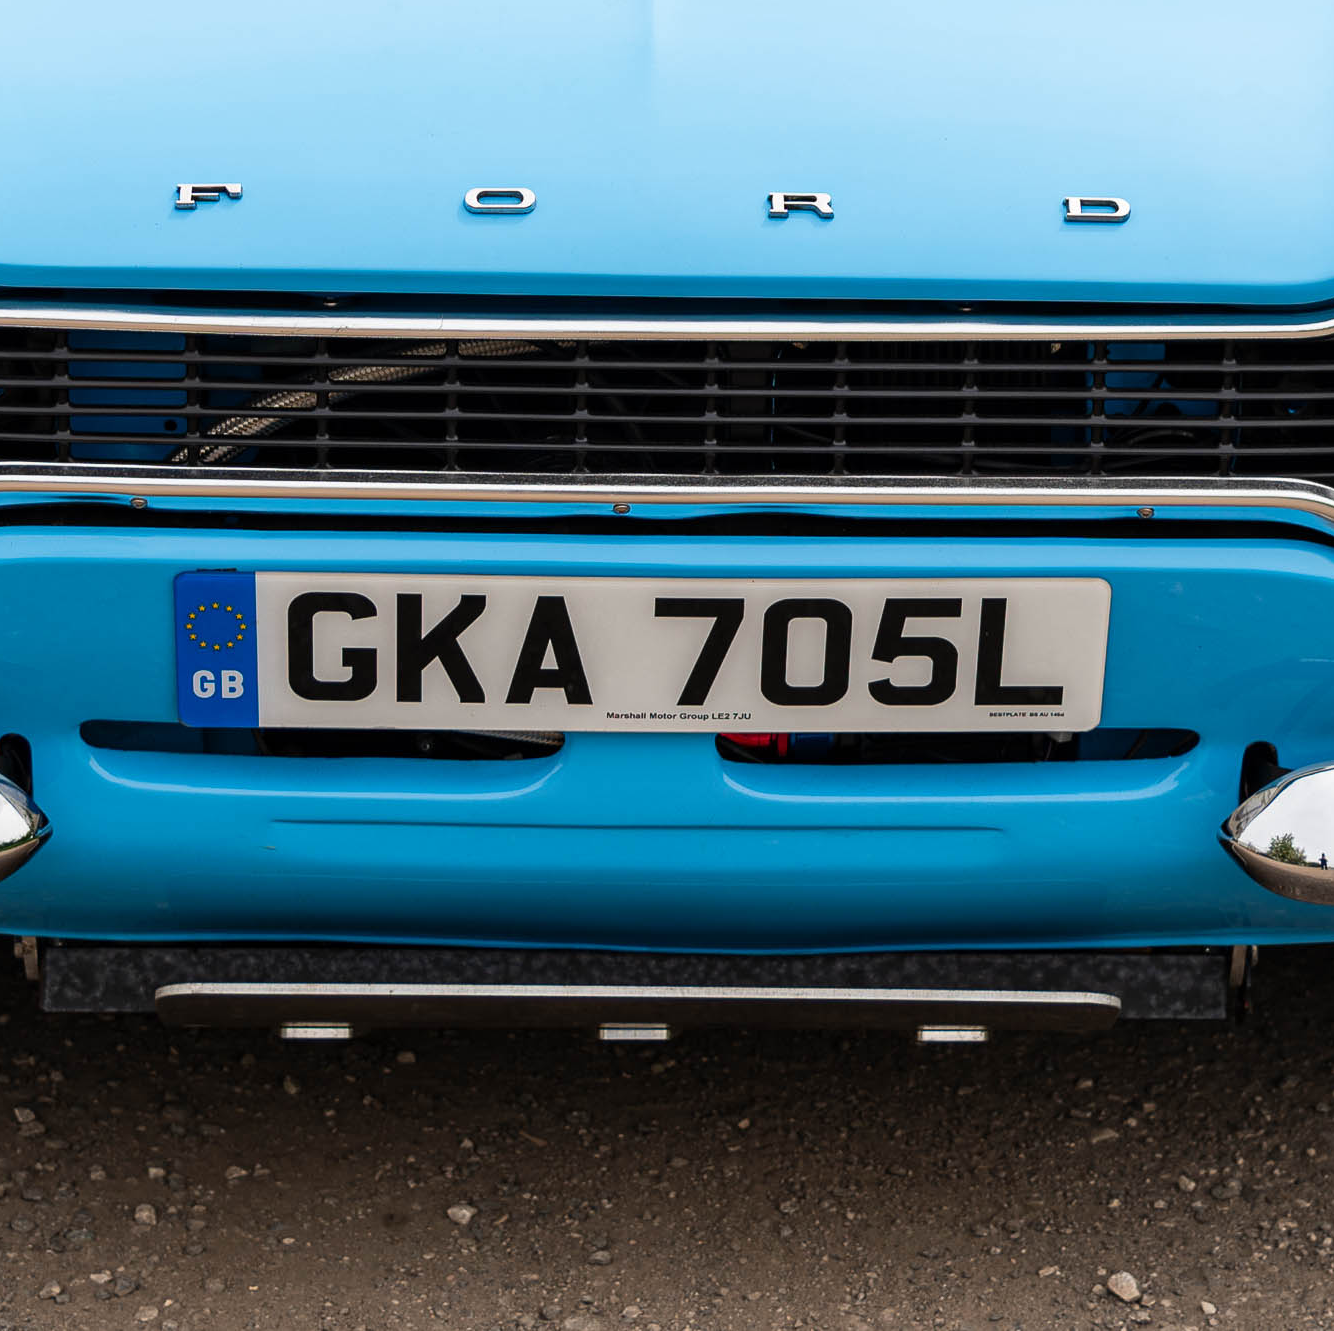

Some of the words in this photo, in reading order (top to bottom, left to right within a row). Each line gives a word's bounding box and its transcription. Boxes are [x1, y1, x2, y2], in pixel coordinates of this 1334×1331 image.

[175, 182, 1132, 223] FORD
[287, 591, 593, 705] GKA
[654, 597, 1064, 706] 705L
[192, 669, 245, 699] GB
[680, 713, 709, 721] Group
